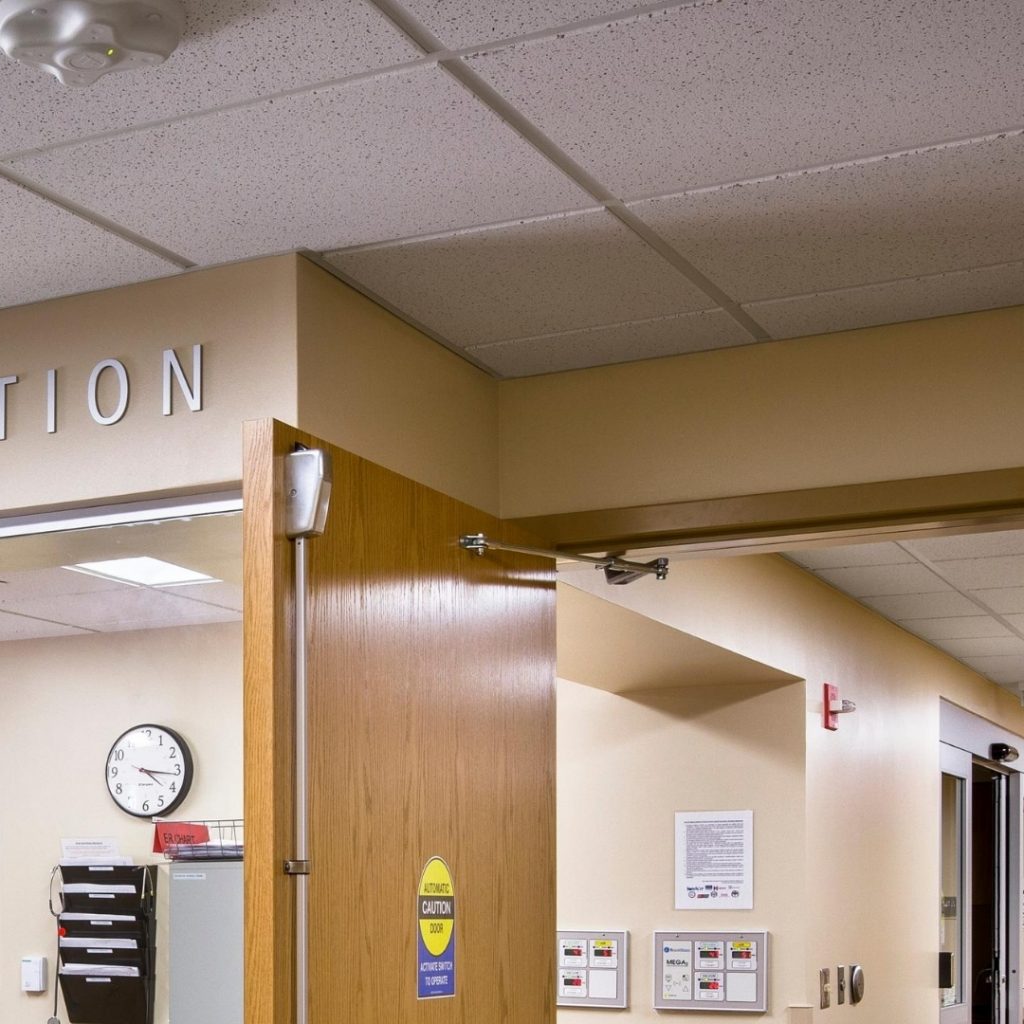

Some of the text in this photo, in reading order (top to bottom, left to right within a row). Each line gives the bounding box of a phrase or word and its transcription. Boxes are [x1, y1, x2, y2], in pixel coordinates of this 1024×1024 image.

[114, 749, 124, 761] 10
[169, 747, 176, 759] 2
[111, 767, 118, 778] 9
[175, 764, 181, 776] 3
[115, 783, 123, 794] 8
[169, 781, 176, 793] 4
[142, 800, 150, 811] 6
[157, 795, 164, 807] 5
[424, 883, 450, 894] AUTOMATIC
[422, 901, 451, 914] CAUTION
[430, 923, 443, 934] DOOR
